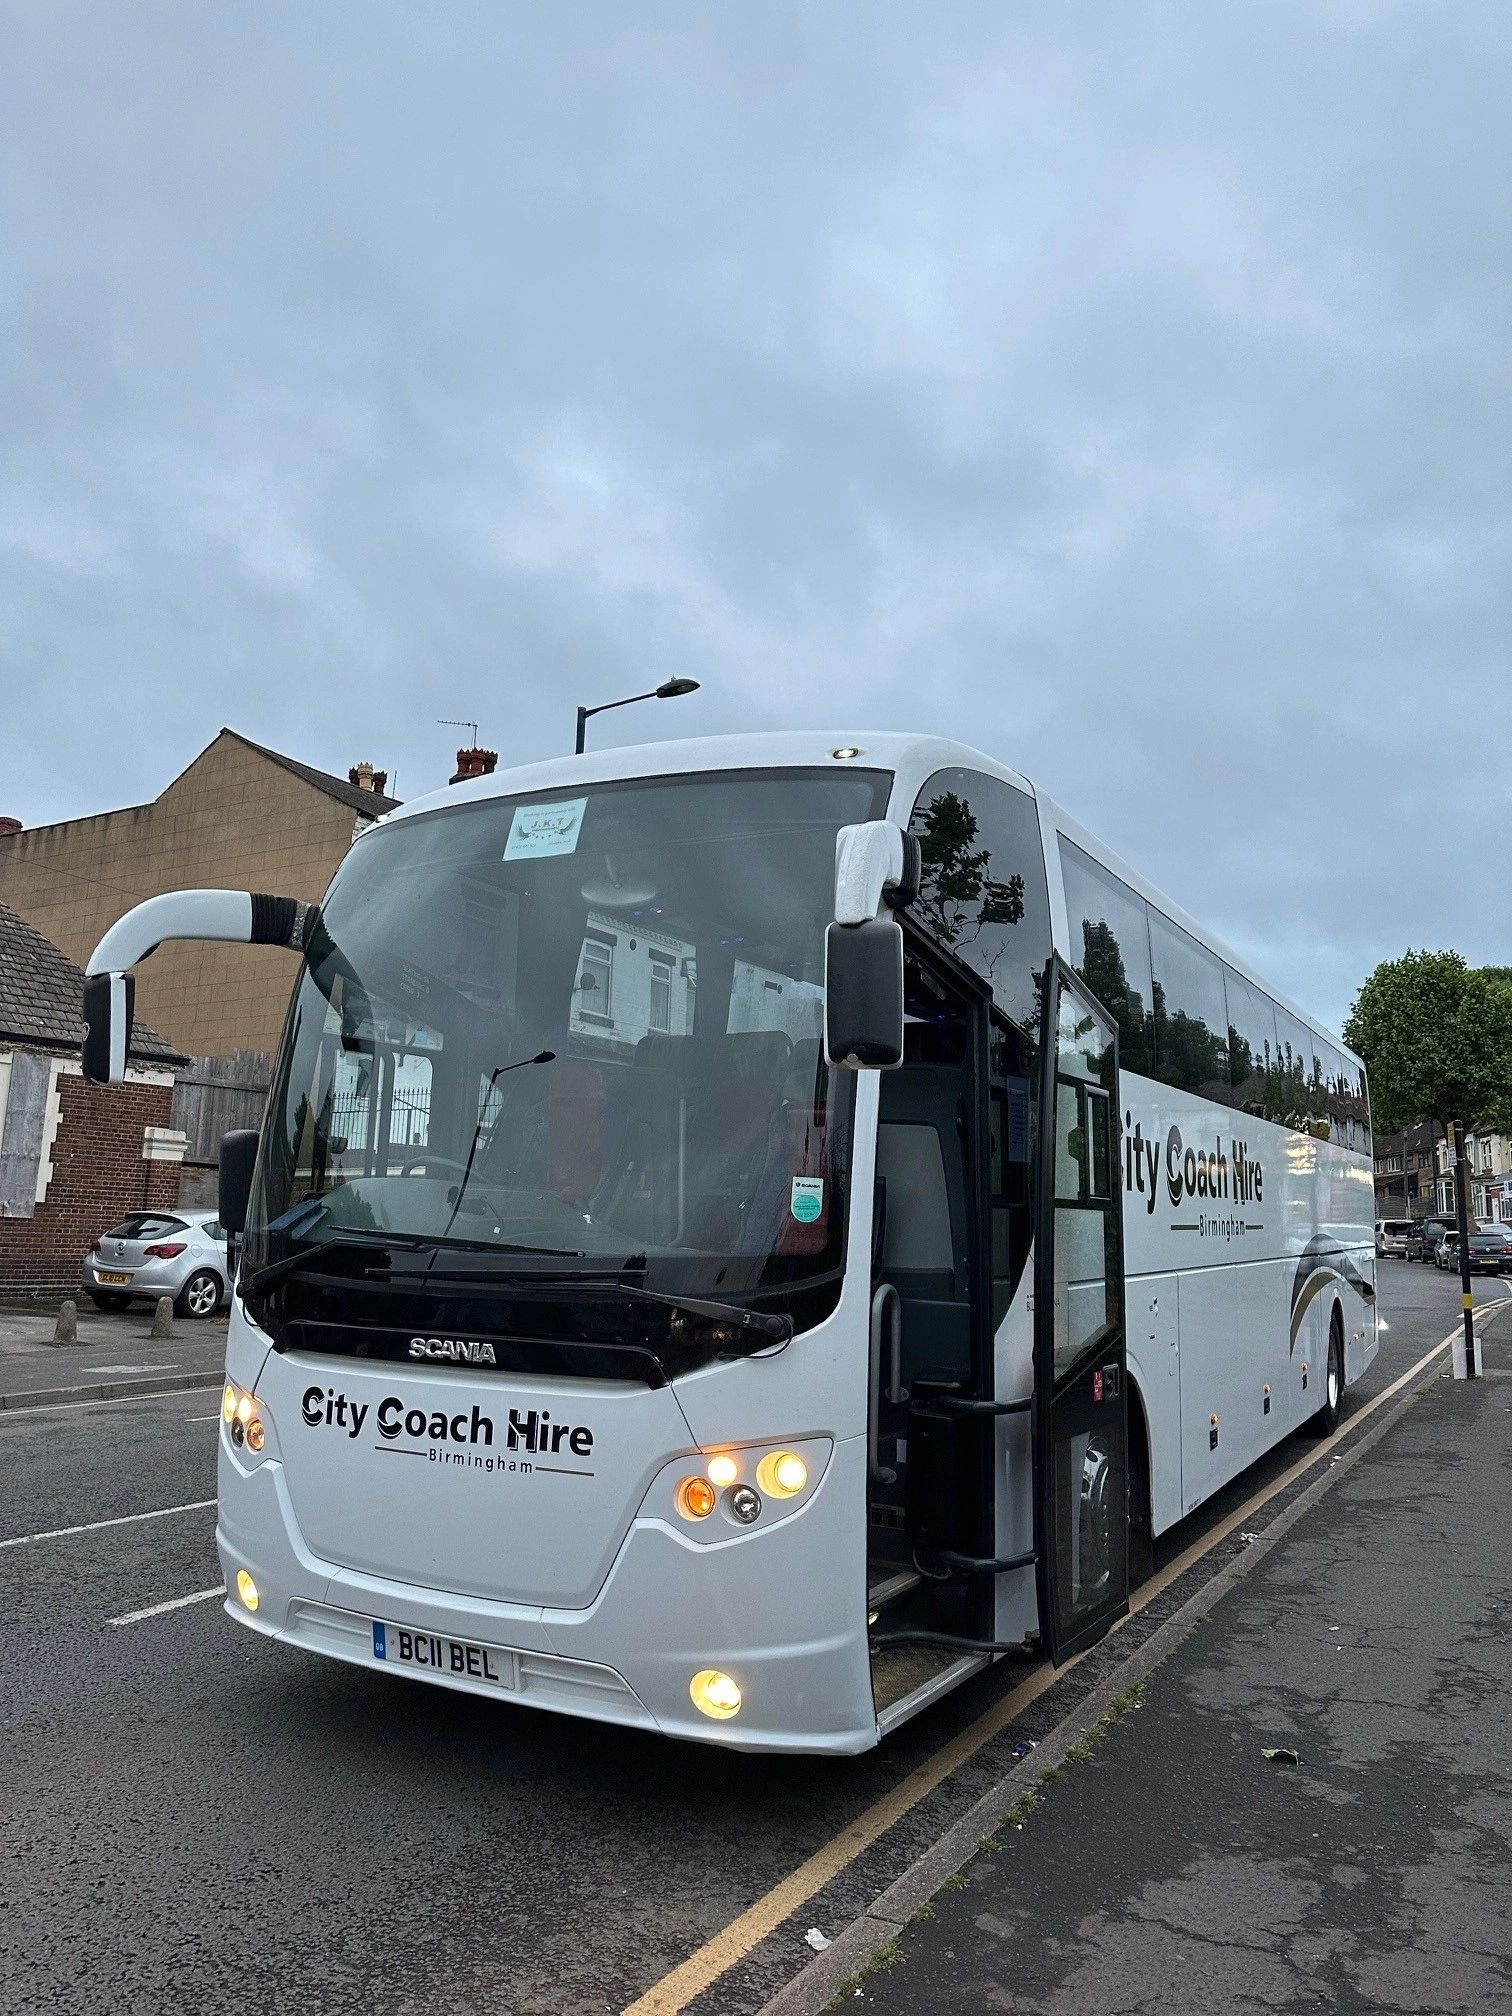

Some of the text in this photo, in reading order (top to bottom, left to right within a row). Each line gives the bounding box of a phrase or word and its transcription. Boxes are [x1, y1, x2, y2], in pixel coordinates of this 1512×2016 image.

[1121, 1110, 1160, 1215] ity
[1166, 1125, 1229, 1207] Coach
[1232, 1139, 1263, 1205] Hire
[1199, 1214, 1246, 1242] Birmingham
[408, 1337, 497, 1364] SCANIA
[301, 1386, 594, 1456] City Coach Hire
[428, 1448, 533, 1473] Birmingham
[399, 1630, 499, 1681] BC11 BEL
